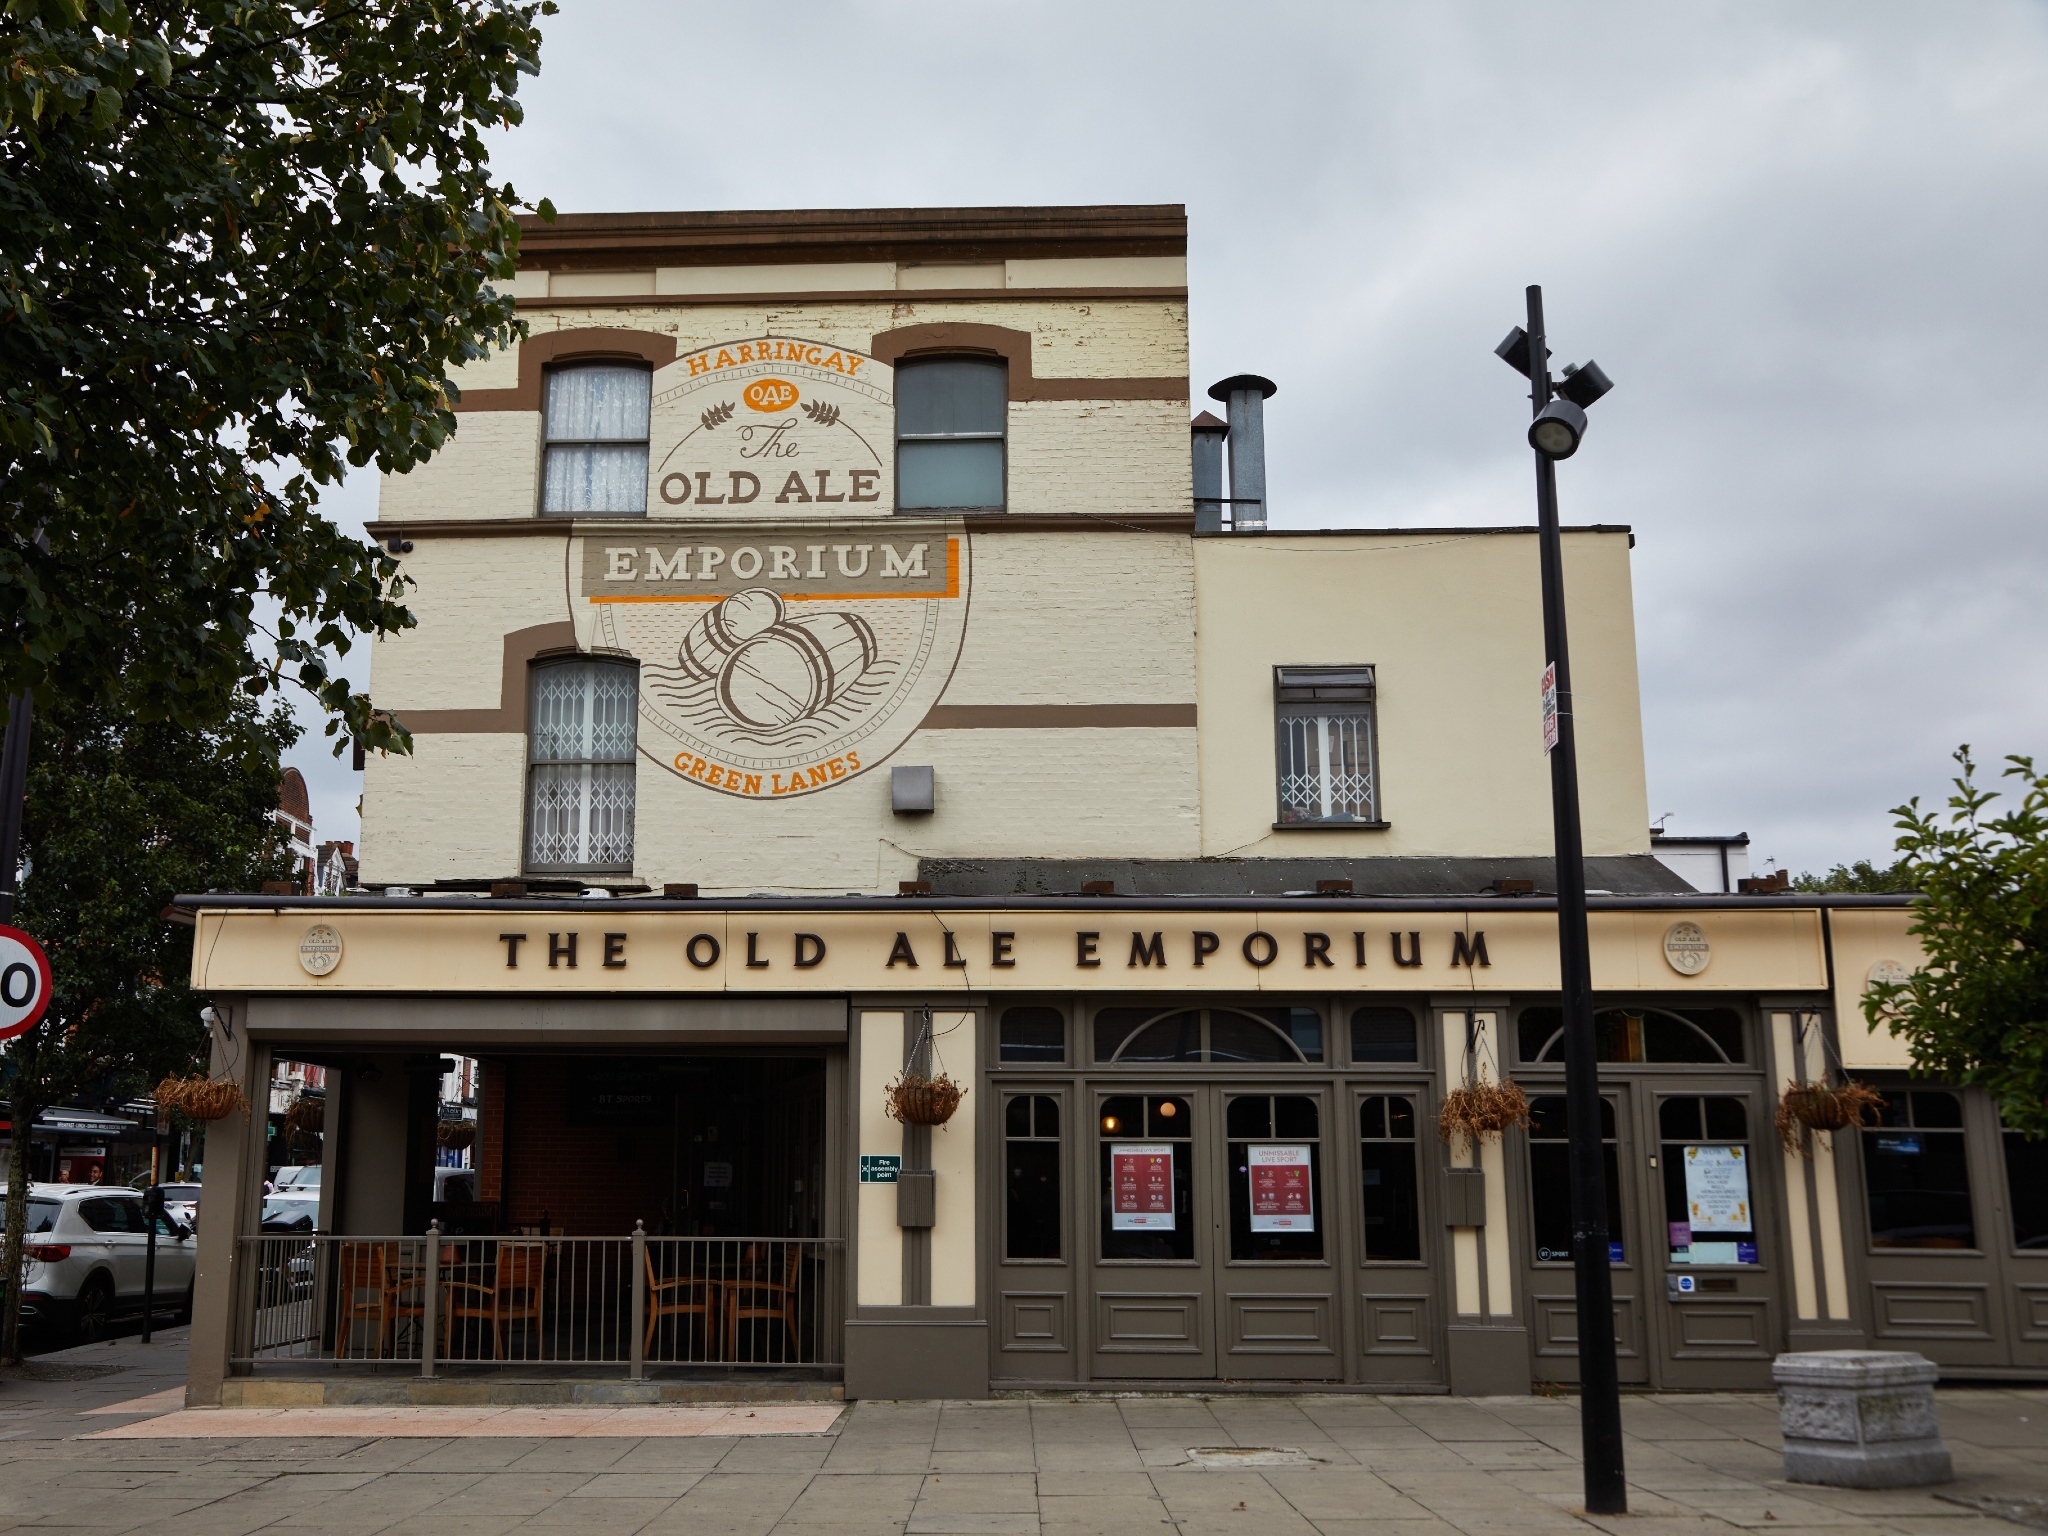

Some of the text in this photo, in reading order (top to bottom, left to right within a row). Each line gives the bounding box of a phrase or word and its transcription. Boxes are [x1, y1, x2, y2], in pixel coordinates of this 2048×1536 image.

[686, 340, 865, 377] HARRINGAY
[749, 384, 794, 405] OAE
[736, 417, 801, 460] The
[659, 469, 881, 505] OLD ALE
[603, 543, 931, 584] EMPORIUM
[673, 751, 862, 795] GREEN LANES
[499, 930, 1492, 968] THE OLD ALE EMPORIUM
[598, 1094, 653, 1104] BT SPORTS
